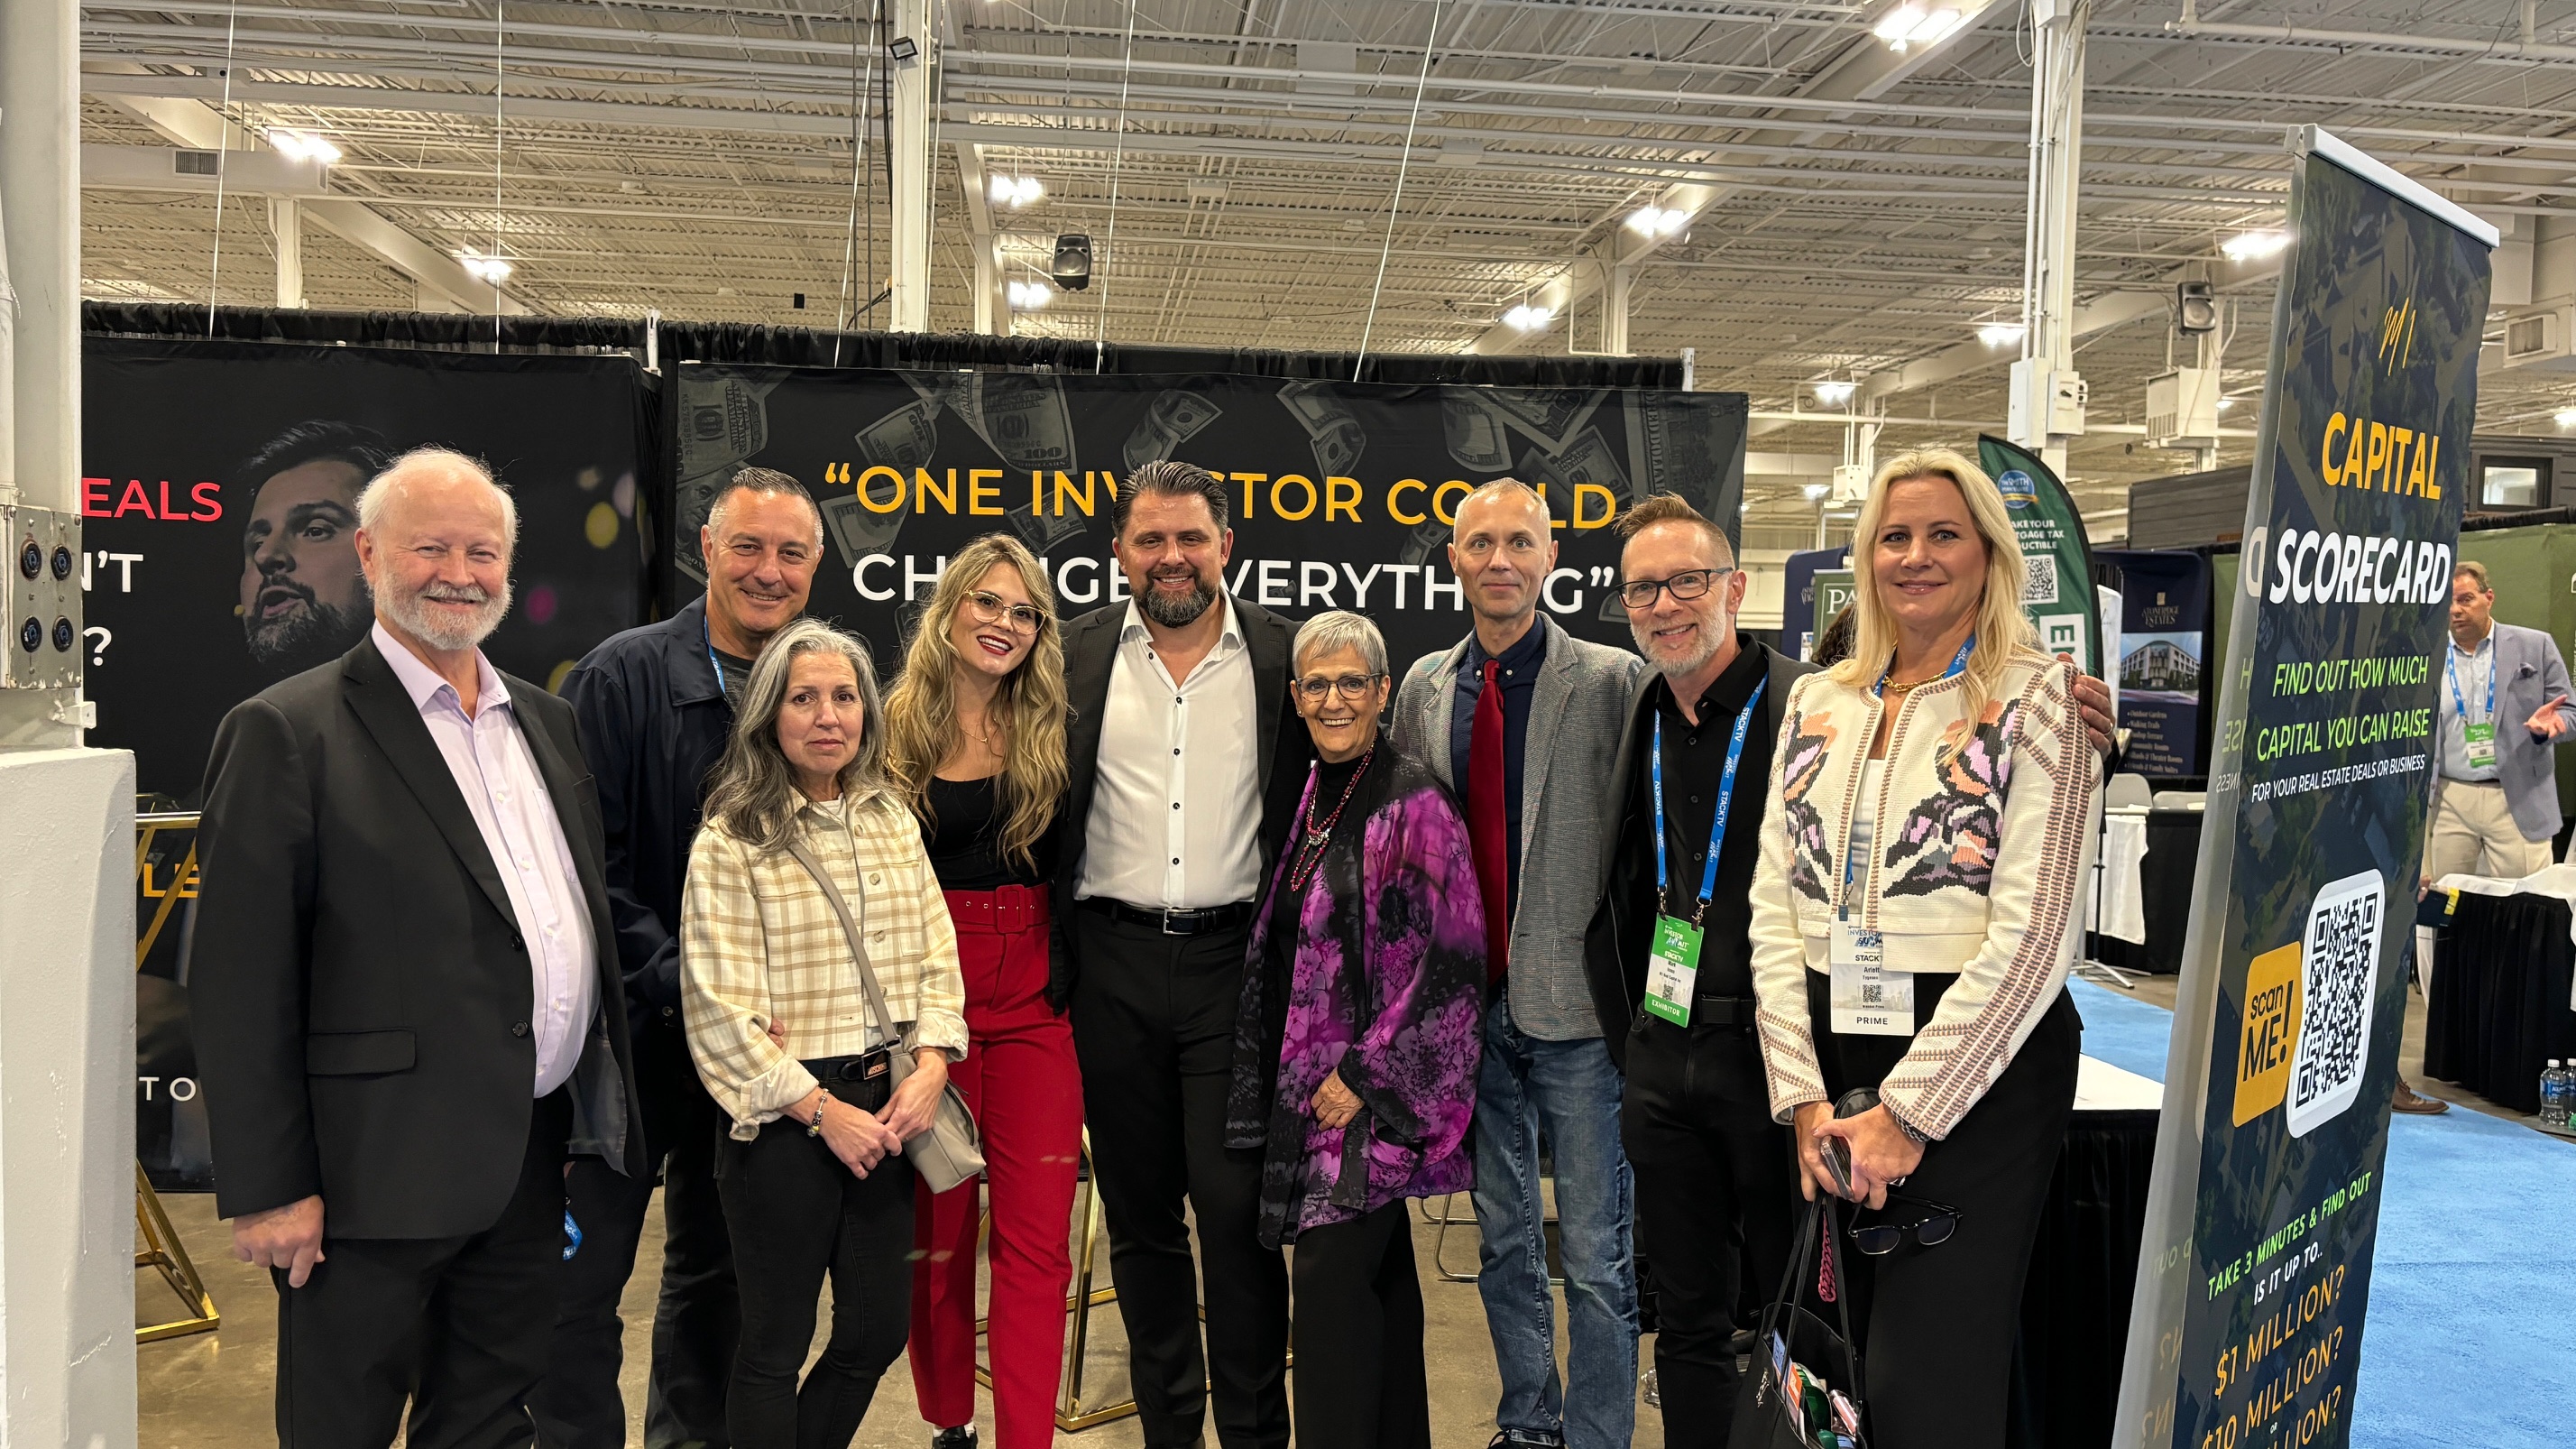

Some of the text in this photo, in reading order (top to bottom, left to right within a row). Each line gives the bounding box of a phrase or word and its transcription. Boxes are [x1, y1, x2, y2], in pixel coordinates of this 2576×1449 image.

[1024, 447, 1063, 459] 100
[2322, 411, 2442, 500] CAPITAL
[81, 477, 223, 522] EALS
[824, 462, 1616, 529] “ONE INTOR COLD
[2010, 519, 2056, 529] AKE YOUR
[2015, 529, 2065, 540] TGAGE TAX
[2020, 540, 2057, 550] UCTIBLE
[853, 553, 1131, 604] CHGE
[2269, 528, 2452, 605] SCORECARD
[2272, 661, 2313, 697] FIND
[2315, 660, 2349, 693] OUT
[2349, 657, 2387, 689] HOW
[2387, 655, 2429, 687] MUCH
[1734, 706, 1750, 743] STACKTV
[2257, 708, 2431, 761] CAPITAL YOU CAN RAISE
[2251, 753, 2425, 803] FOR YOUR REAL ESTATE DEALS OR BUSINESS
[1716, 790, 1729, 826] STACKTV
[1664, 950, 1684, 963] STACKTV
[1651, 999, 1680, 1017] EXHIBITOR
[1856, 1016, 1889, 1025] PRIME
[2250, 983, 2284, 1020] scan
[2243, 980, 2294, 1082] ME!
[2208, 1171, 2372, 1301] TAKE 3 MINUTES & FIND OUT
[2254, 1241, 2323, 1306] IS IT UP TO..
[2214, 1345, 2238, 1399] $1
[2245, 1264, 2345, 1372] MILLION?
[2244, 1325, 2343, 1438] MILLION?
[2269, 1421, 2277, 1435] OR
